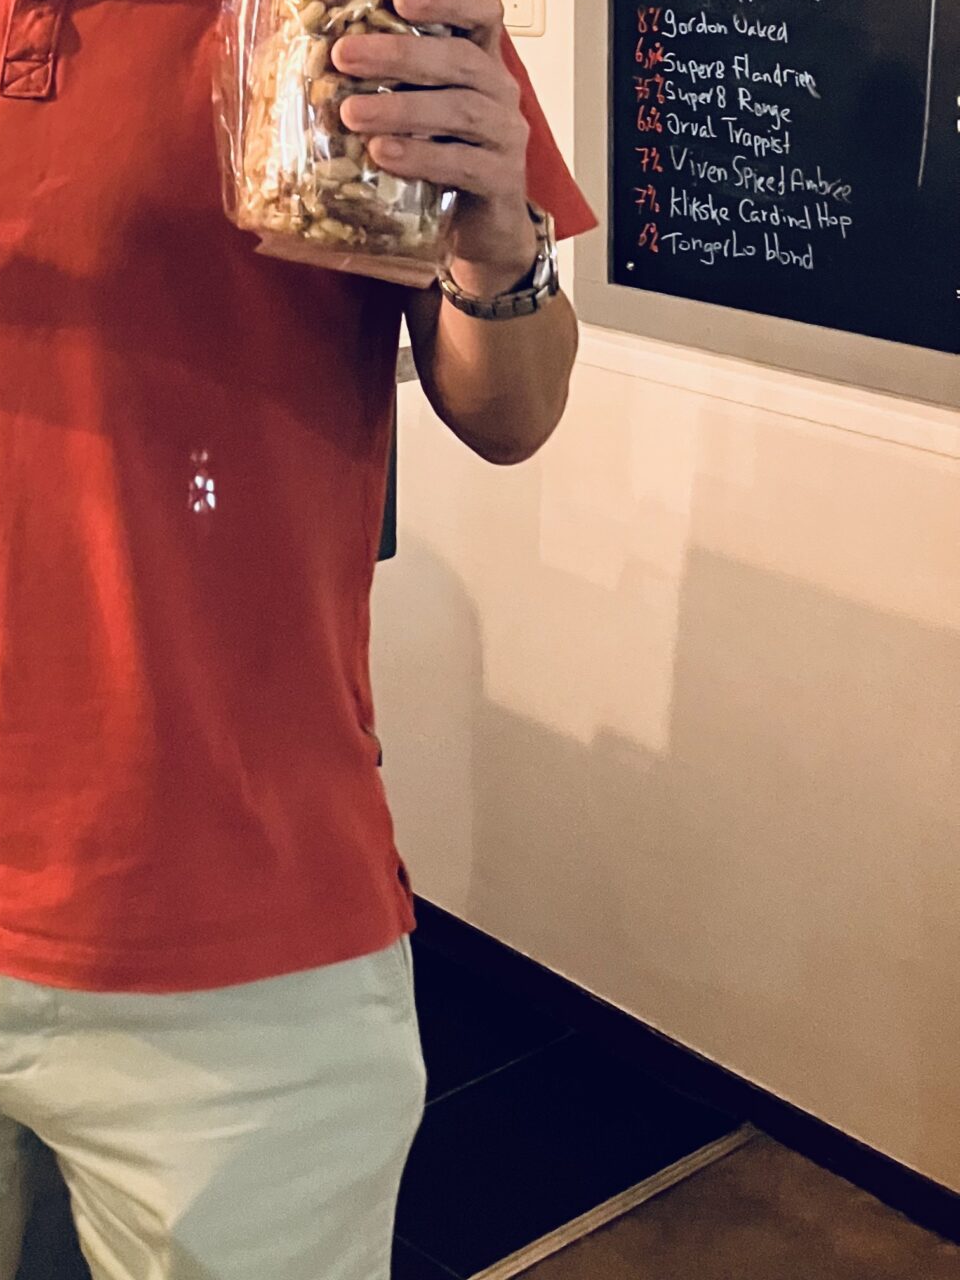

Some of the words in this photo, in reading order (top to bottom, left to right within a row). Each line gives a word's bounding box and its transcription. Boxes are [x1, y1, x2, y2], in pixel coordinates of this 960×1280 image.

[666, 113, 718, 139] Orval
[721, 116, 790, 157] Trappist
[635, 146, 664, 173] 7%
[670, 144, 728, 182] Viven
[634, 184, 661, 214] 7%
[815, 201, 852, 239] Hop
